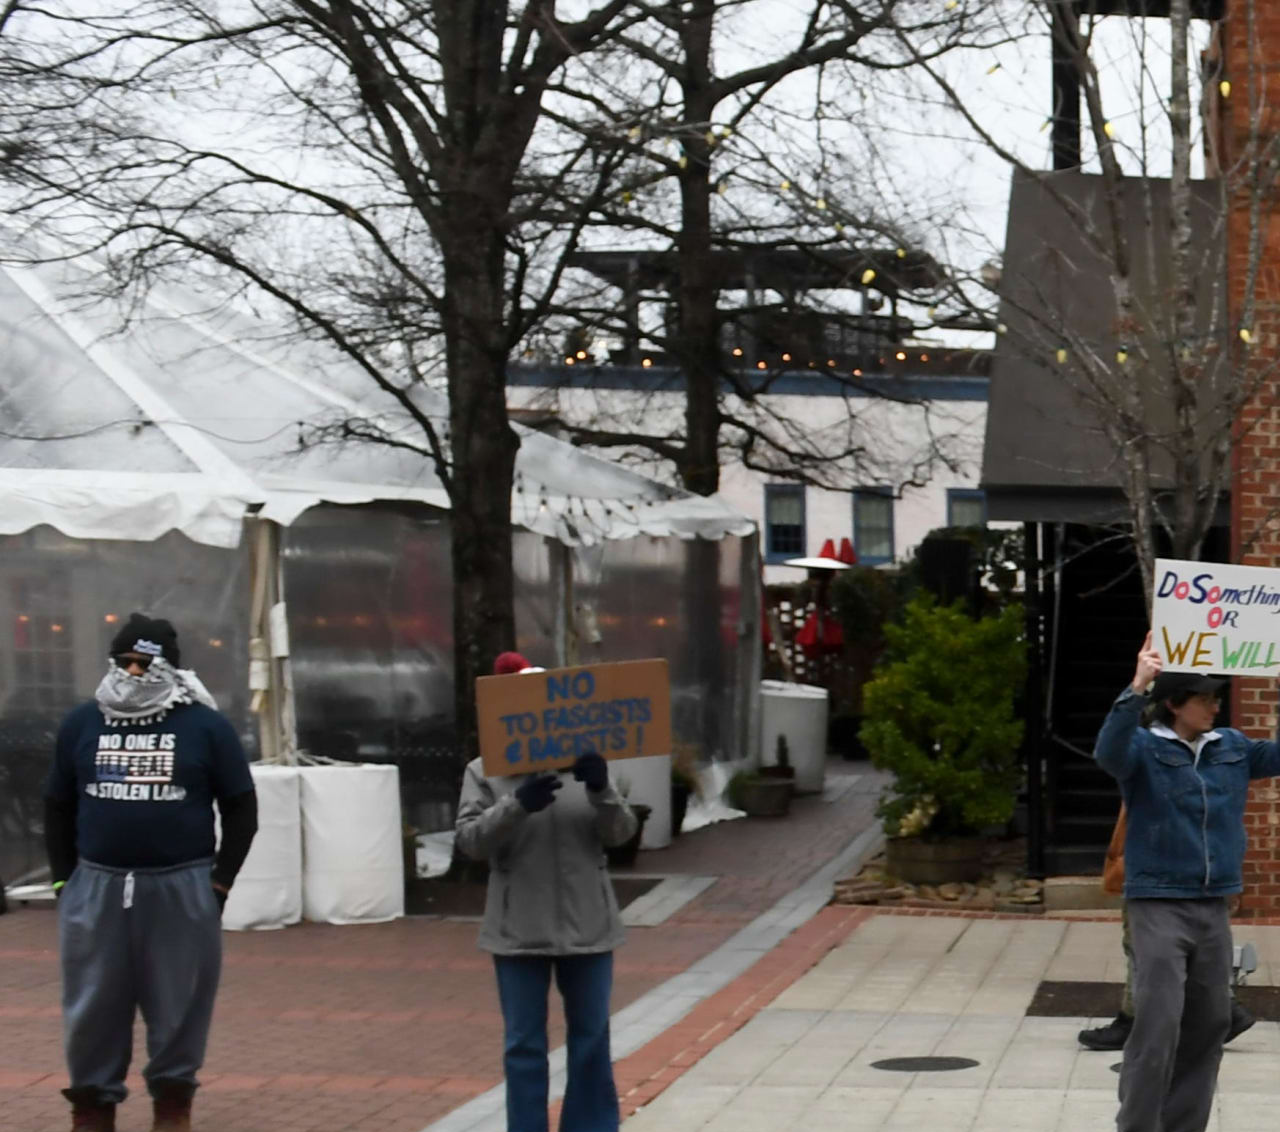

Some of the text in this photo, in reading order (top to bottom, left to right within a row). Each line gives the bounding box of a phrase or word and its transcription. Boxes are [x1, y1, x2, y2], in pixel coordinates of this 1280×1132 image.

[1207, 606, 1239, 629] OR
[1161, 626, 1280, 669] WE WILL
[547, 670, 595, 702] NO
[499, 698, 652, 736] TO FASCISTS
[98, 733, 176, 750] NO ONE IS
[528, 726, 628, 762] RACISTS
[98, 782, 150, 800] STOLEN
